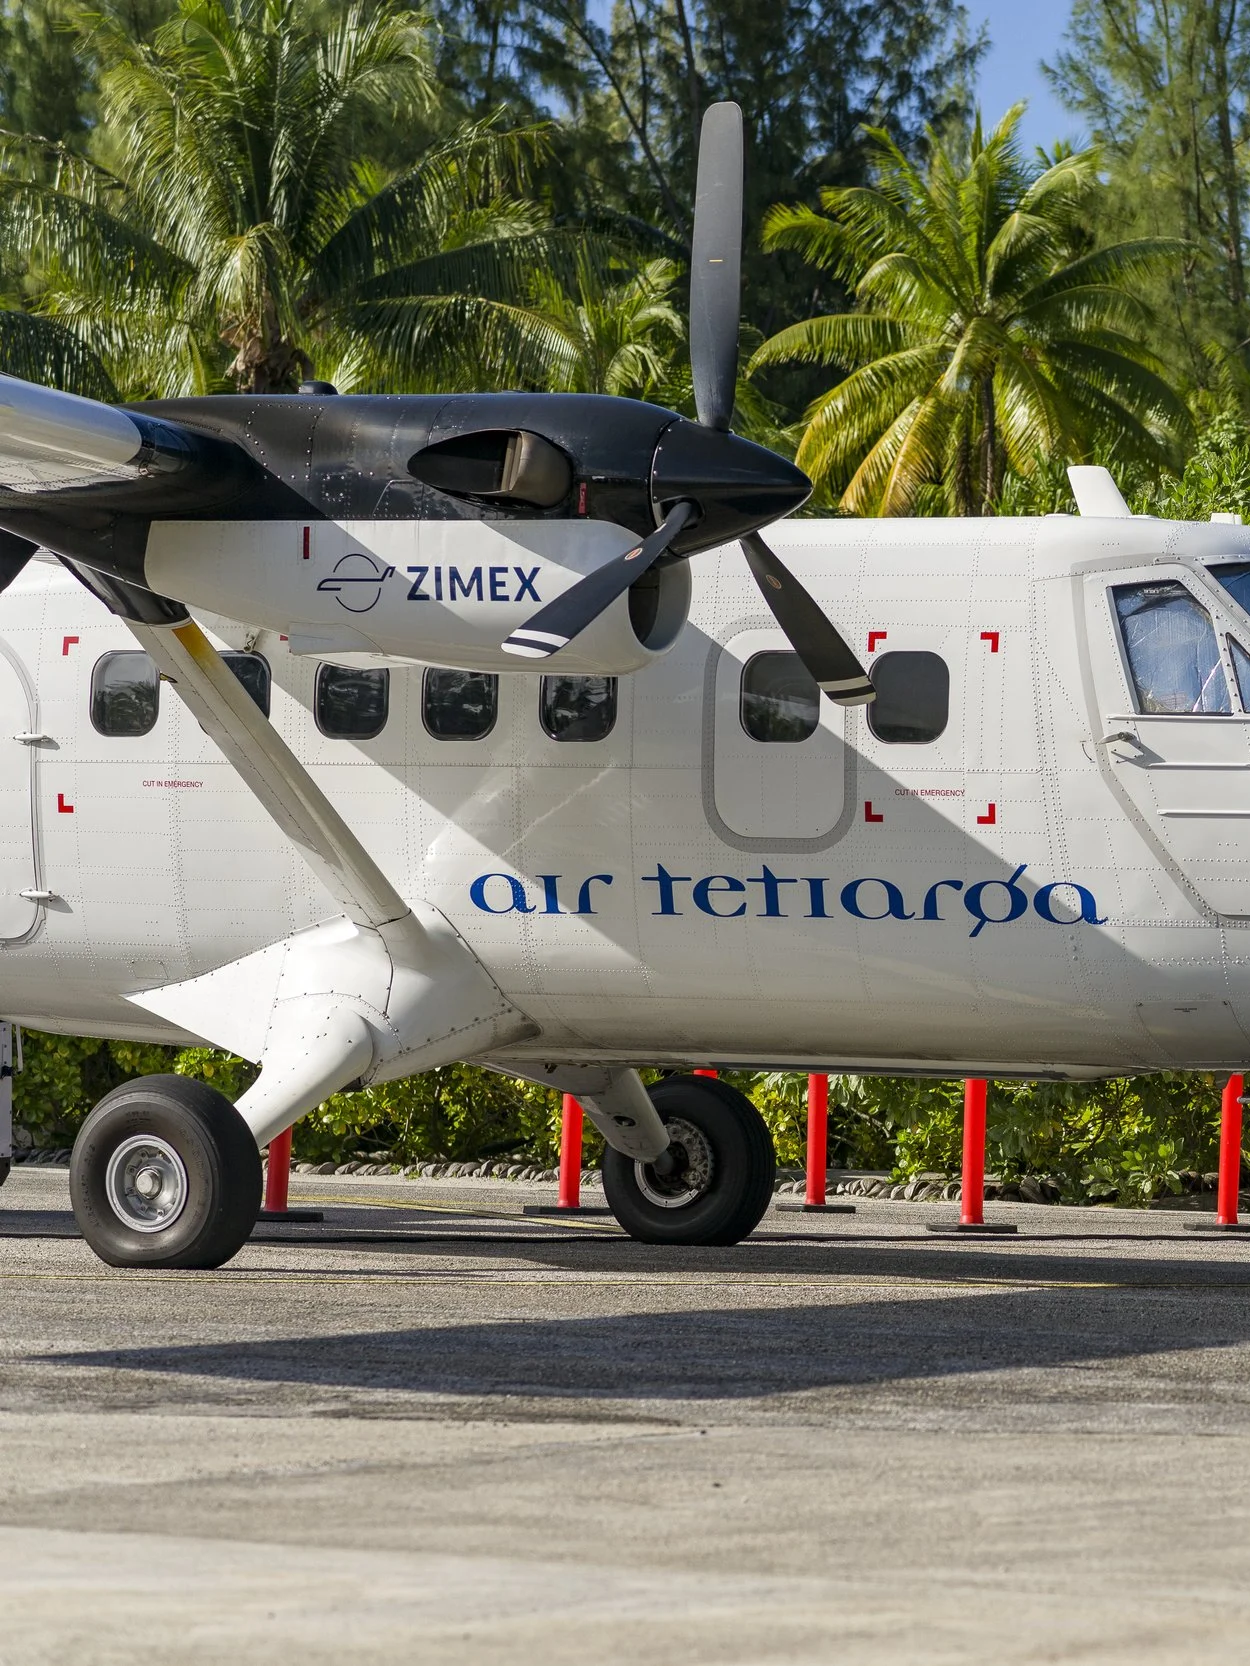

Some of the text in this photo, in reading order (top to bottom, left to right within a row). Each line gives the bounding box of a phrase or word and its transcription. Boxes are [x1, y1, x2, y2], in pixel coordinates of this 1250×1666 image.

[406, 566, 543, 603] ZIMEX
[894, 788, 909, 796] CUT
[920, 789, 965, 797] EMERGENCY
[469, 873, 614, 915] air
